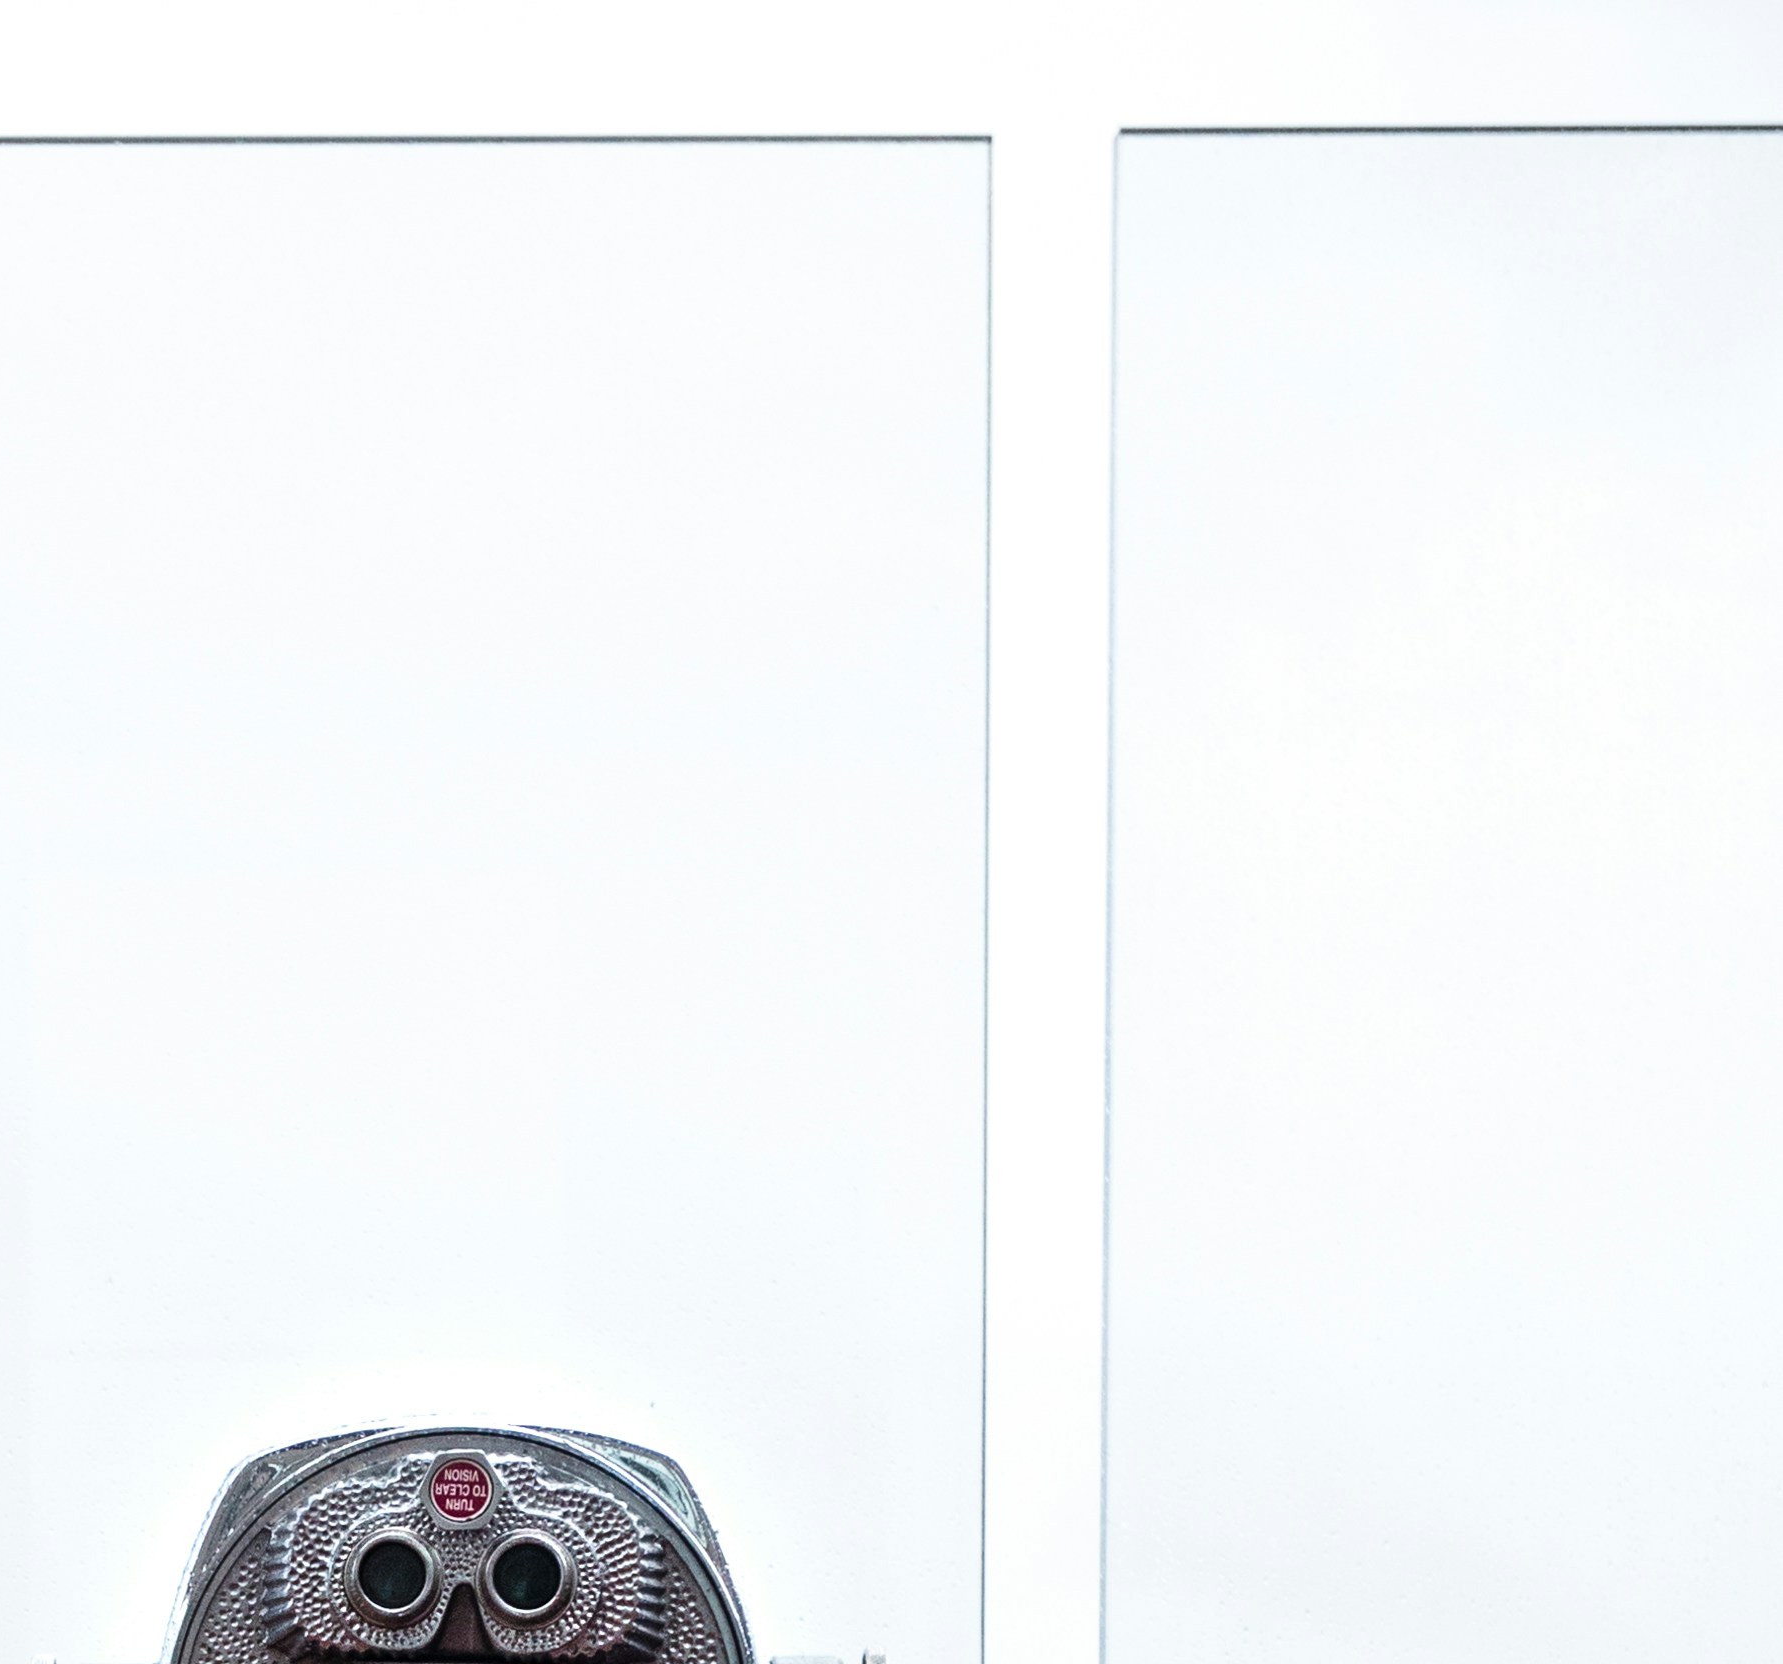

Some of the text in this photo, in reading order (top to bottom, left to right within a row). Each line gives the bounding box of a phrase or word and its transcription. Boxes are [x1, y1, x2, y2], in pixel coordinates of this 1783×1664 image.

[444, 1468, 479, 1482] VISION
[435, 1483, 487, 1498] TO CLEAR
[445, 1498, 474, 1511] TURN
